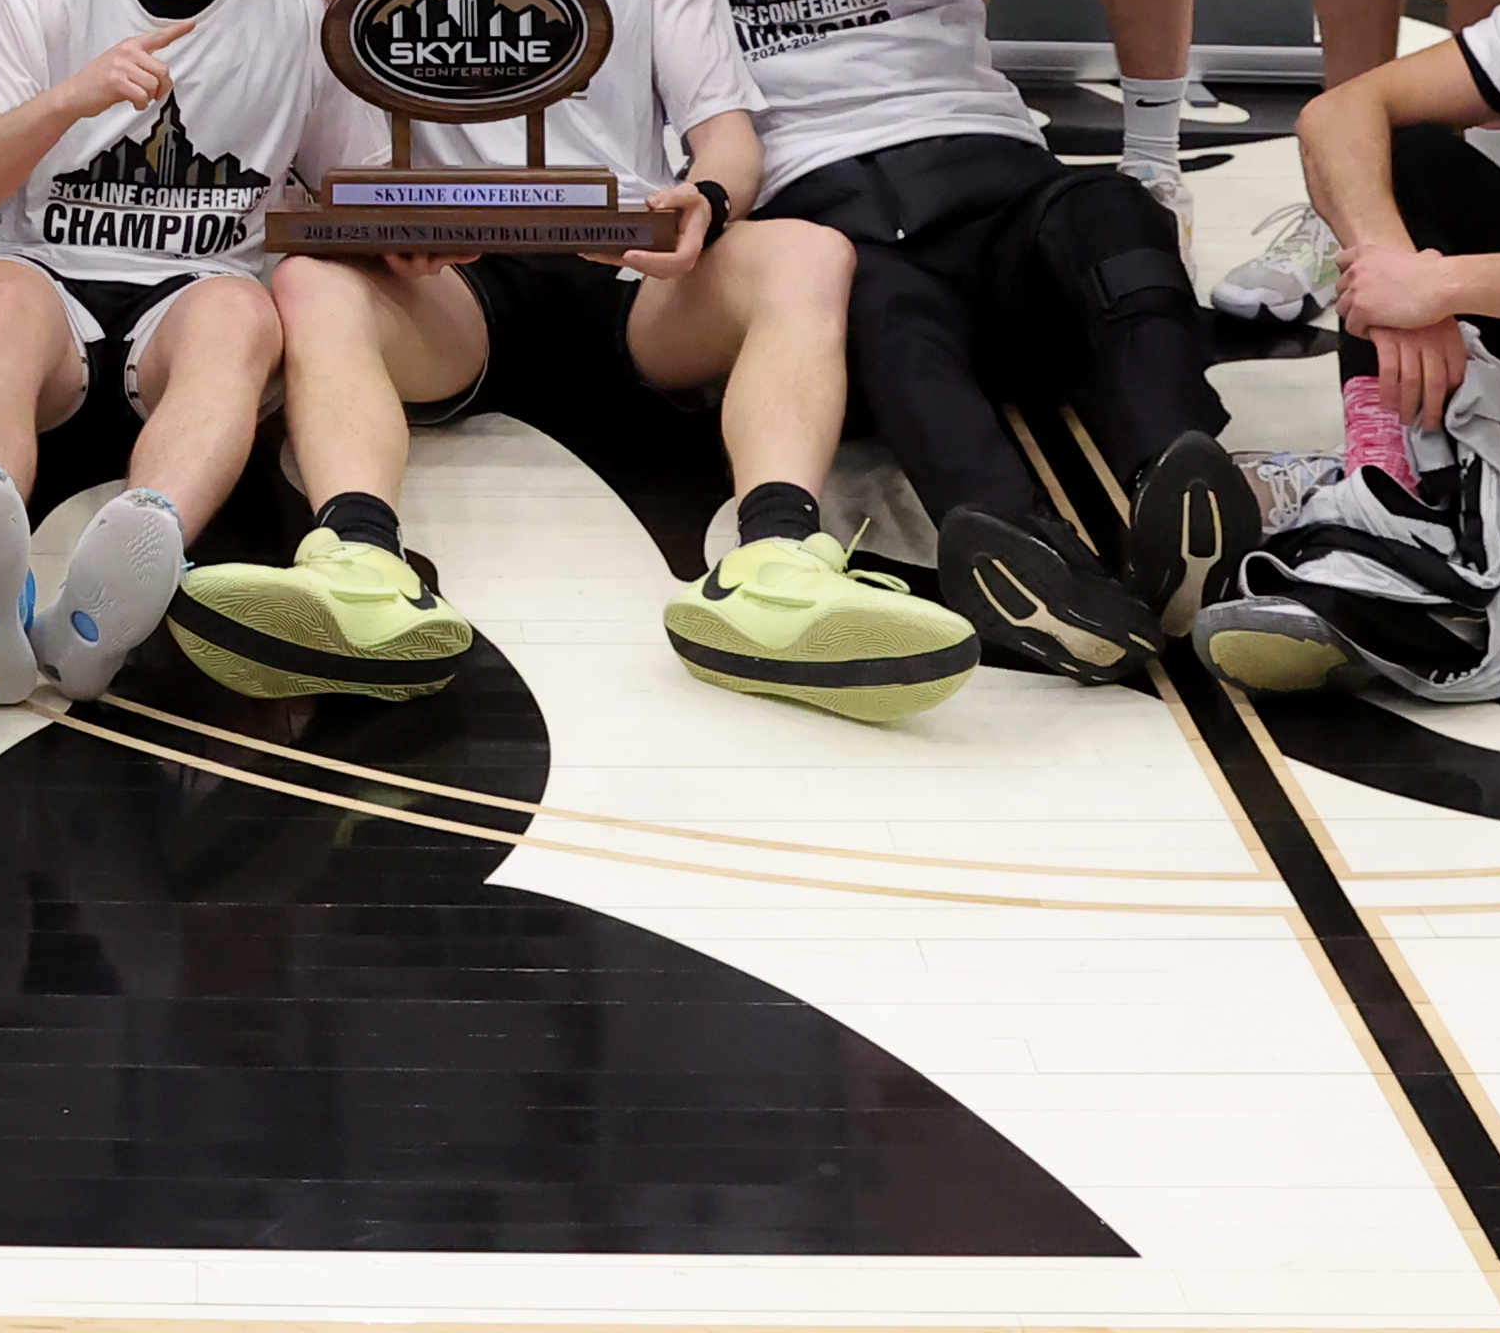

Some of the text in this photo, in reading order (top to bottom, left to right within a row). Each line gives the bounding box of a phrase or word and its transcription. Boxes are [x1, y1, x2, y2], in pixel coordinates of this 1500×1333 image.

[389, 40, 551, 65] SKYLINE
[413, 65, 529, 78] CONFERENCE
[49, 180, 139, 206] SKYLINE
[374, 187, 566, 203] SKYLINE CONFERENCE
[304, 225, 639, 242] 2024-25 MEN'S BASKETBALL CHAMPION
